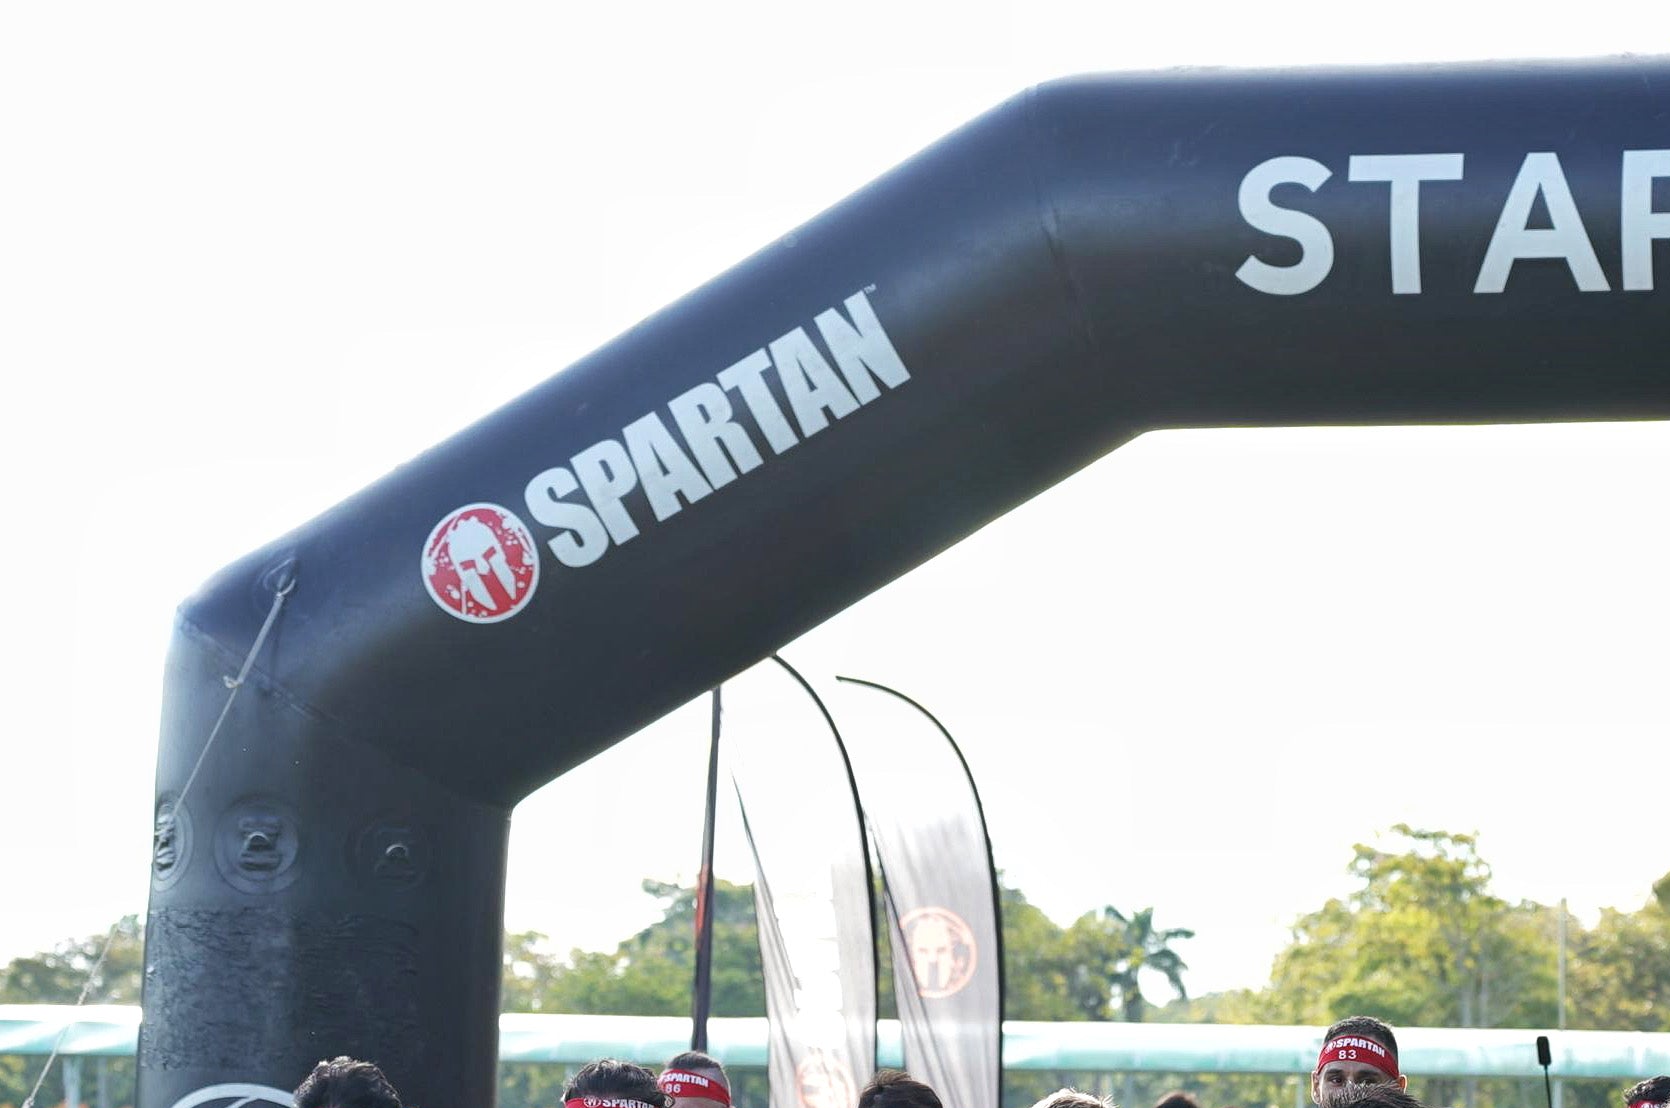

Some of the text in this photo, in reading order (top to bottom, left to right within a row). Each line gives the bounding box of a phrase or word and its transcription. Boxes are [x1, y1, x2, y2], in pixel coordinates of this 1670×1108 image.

[524, 289, 912, 568] SPARTAN
[1336, 1037, 1385, 1058] SPARTAN
[1338, 1050, 1357, 1060] 83
[664, 1073, 709, 1088] SPARTAN
[665, 1083, 682, 1094] 86
